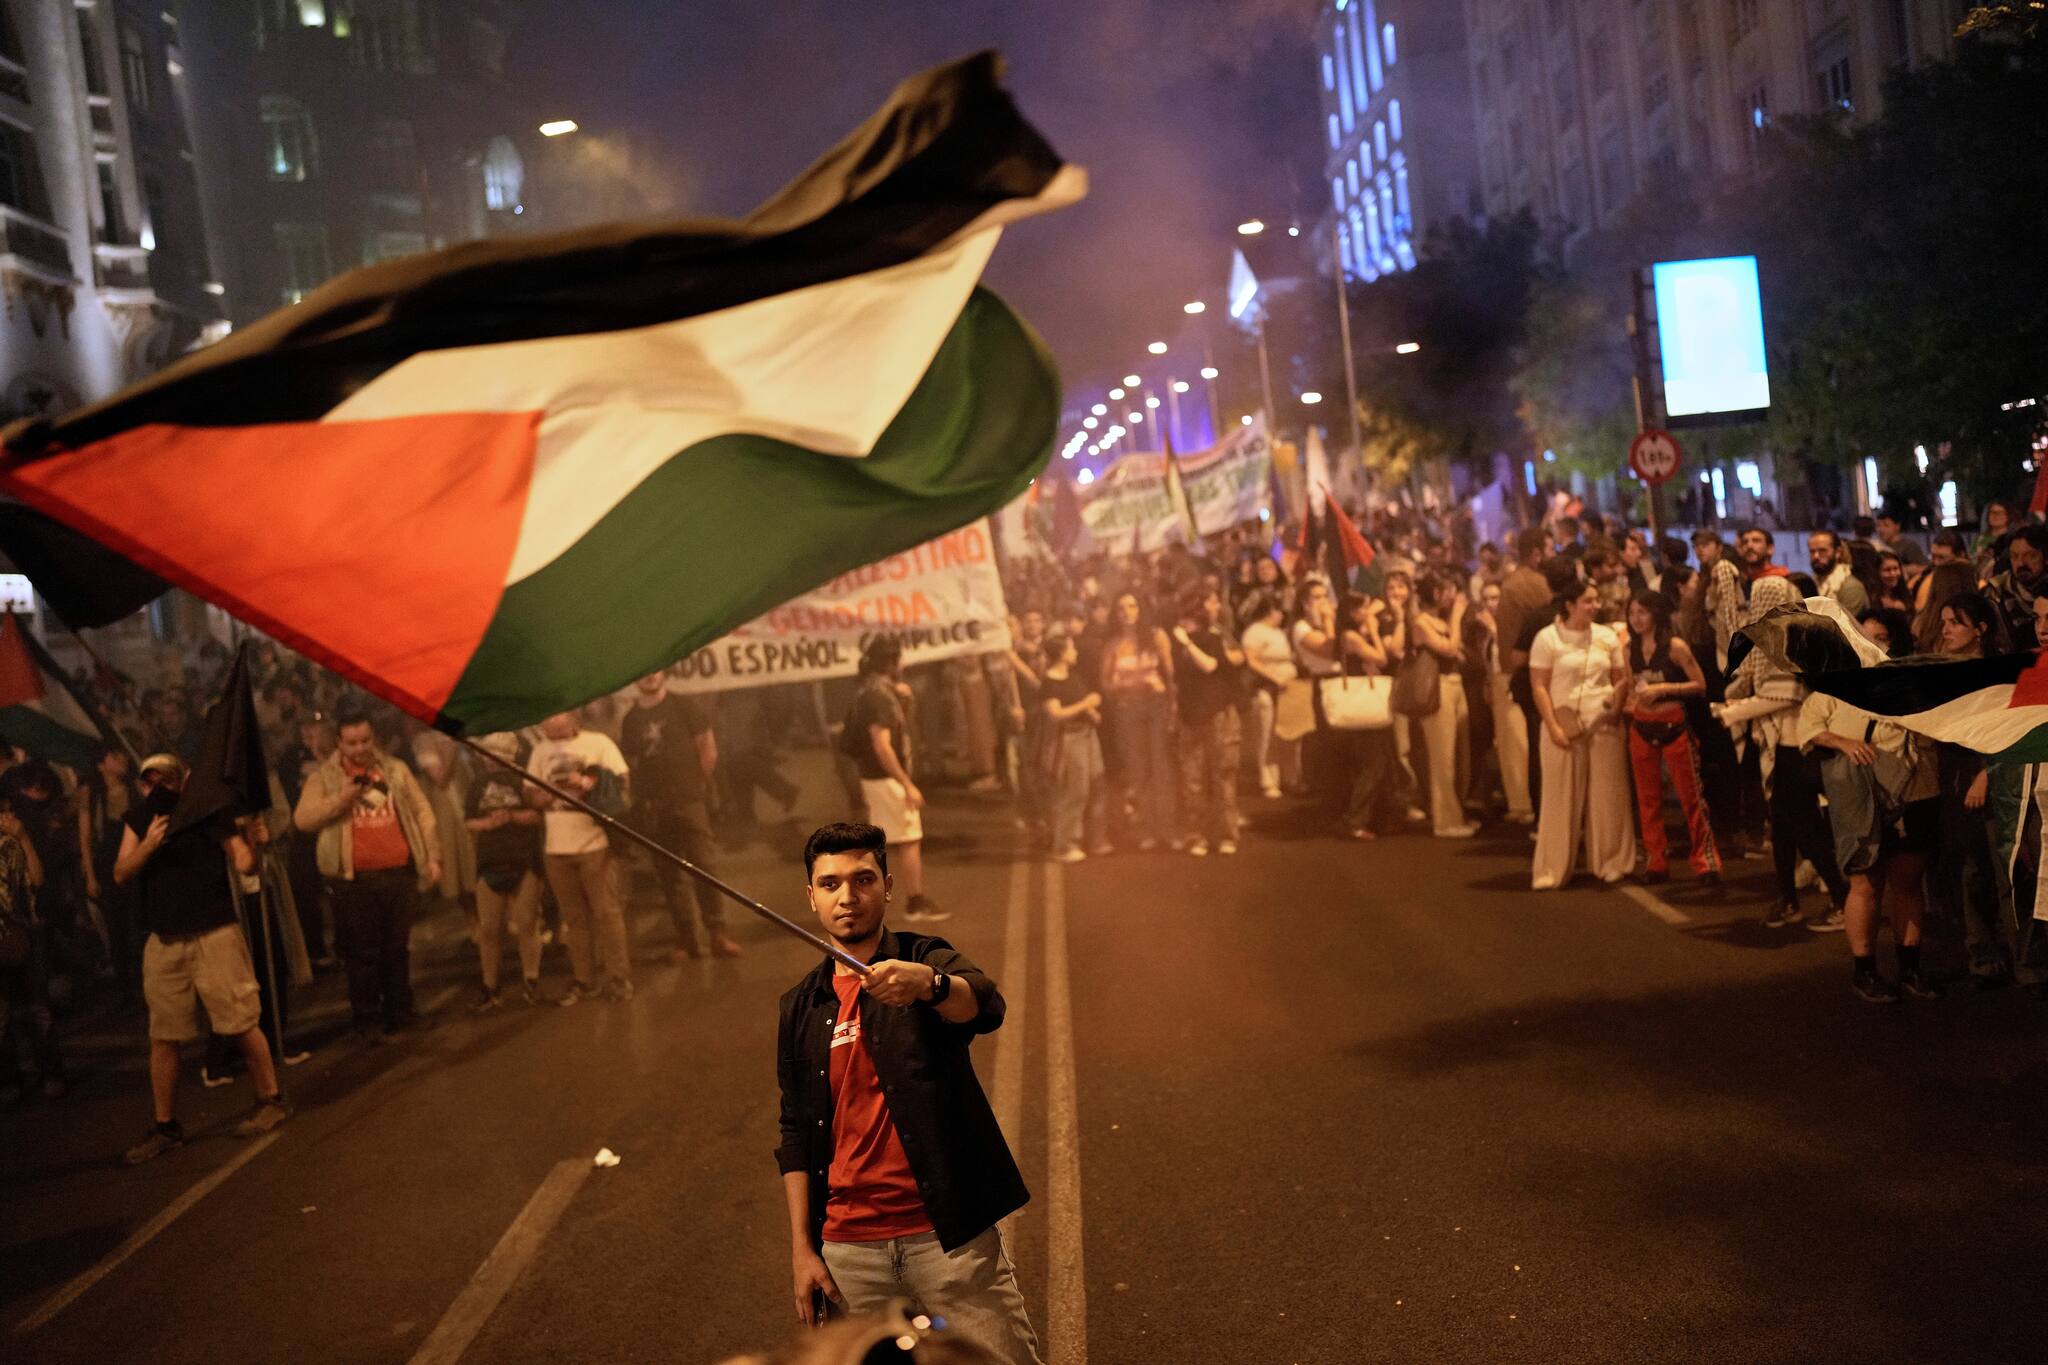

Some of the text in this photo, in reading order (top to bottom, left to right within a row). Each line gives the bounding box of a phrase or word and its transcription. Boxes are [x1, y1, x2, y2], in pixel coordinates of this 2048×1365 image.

[829, 527, 986, 594] ALESTINO
[768, 591, 937, 635] GENOCIDA
[728, 636, 848, 675] ESPAÑOL
